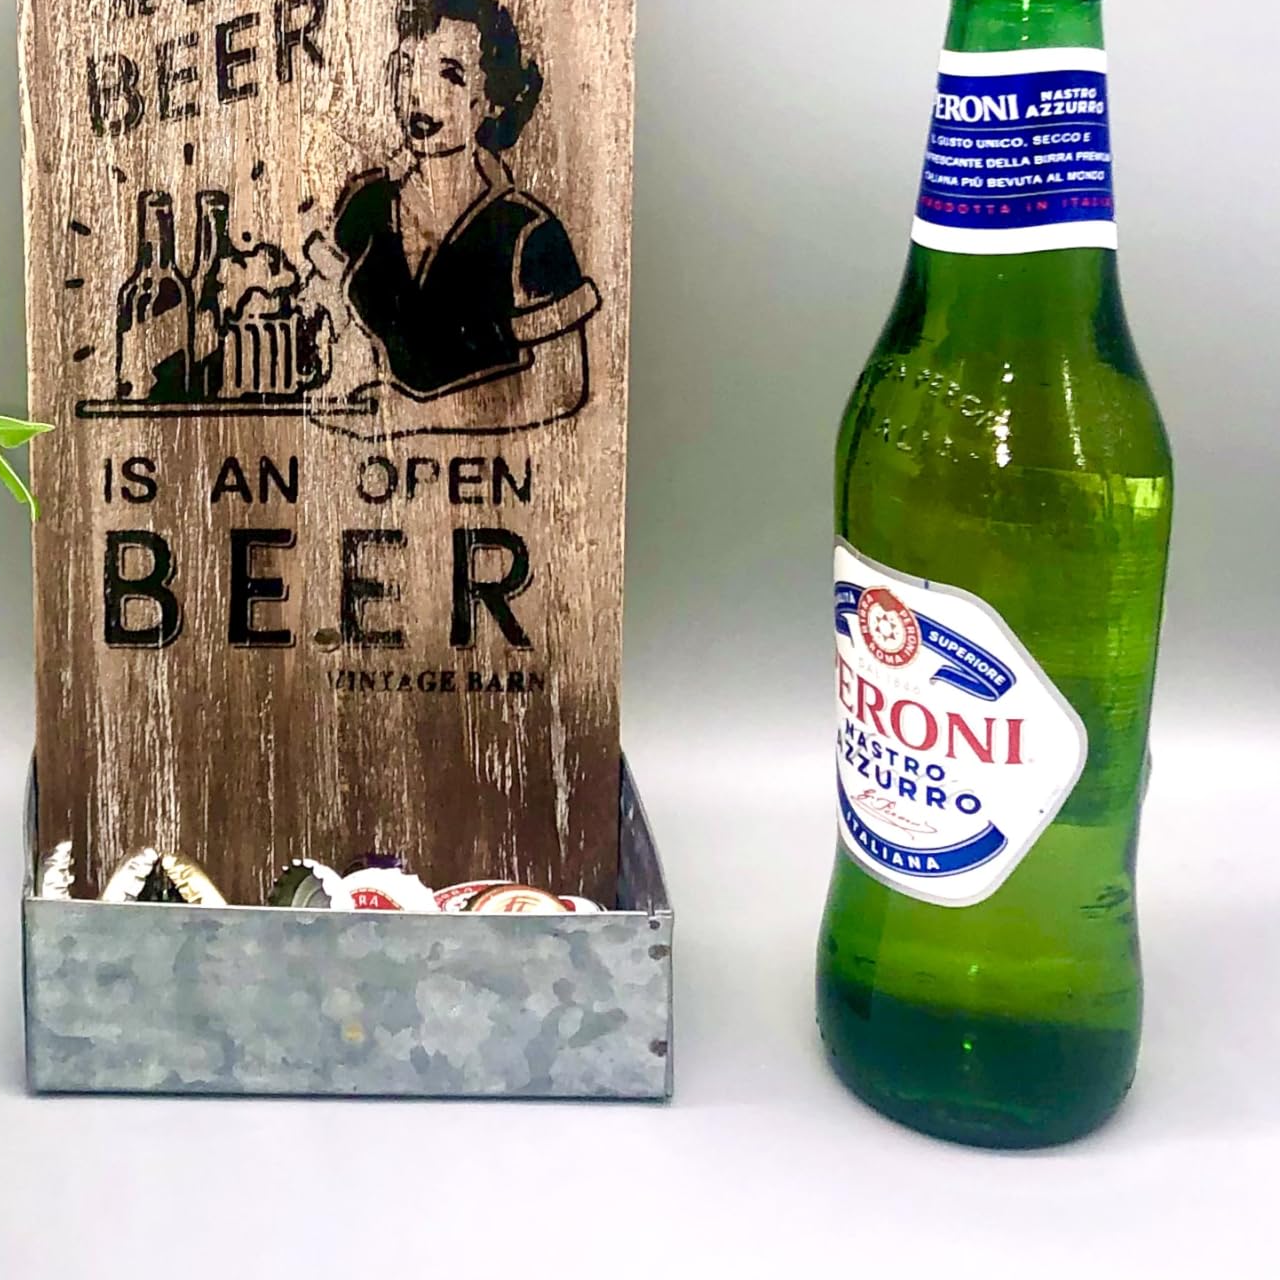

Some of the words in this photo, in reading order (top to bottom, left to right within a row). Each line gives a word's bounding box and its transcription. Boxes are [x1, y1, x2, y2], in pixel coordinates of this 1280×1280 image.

[1040, 87, 1097, 102] NASTRO
[1025, 101, 1105, 119] AZZURRO
[1032, 132, 1081, 146] SECCO
[1083, 132, 1092, 143] E
[986, 157, 1031, 169] DELLA
[1034, 152, 1074, 166] BIRRA
[986, 174, 1043, 189] BEVUTA
[1046, 173, 1065, 183] AL
[1066, 171, 1105, 181] MONDO
[1025, 201, 1048, 213] IN
[104, 456, 157, 505] IS
[211, 456, 299, 505] AN
[357, 456, 532, 506] OPEN
[103, 527, 535, 650] BEER
[927, 630, 1006, 688] SUPERIORE
[327, 670, 457, 693] VINTAGE
[467, 671, 545, 693] BARN
[835, 648, 1025, 765] ERONI
[845, 717, 946, 782] NASTRO
[846, 801, 941, 871] ITALIANA
